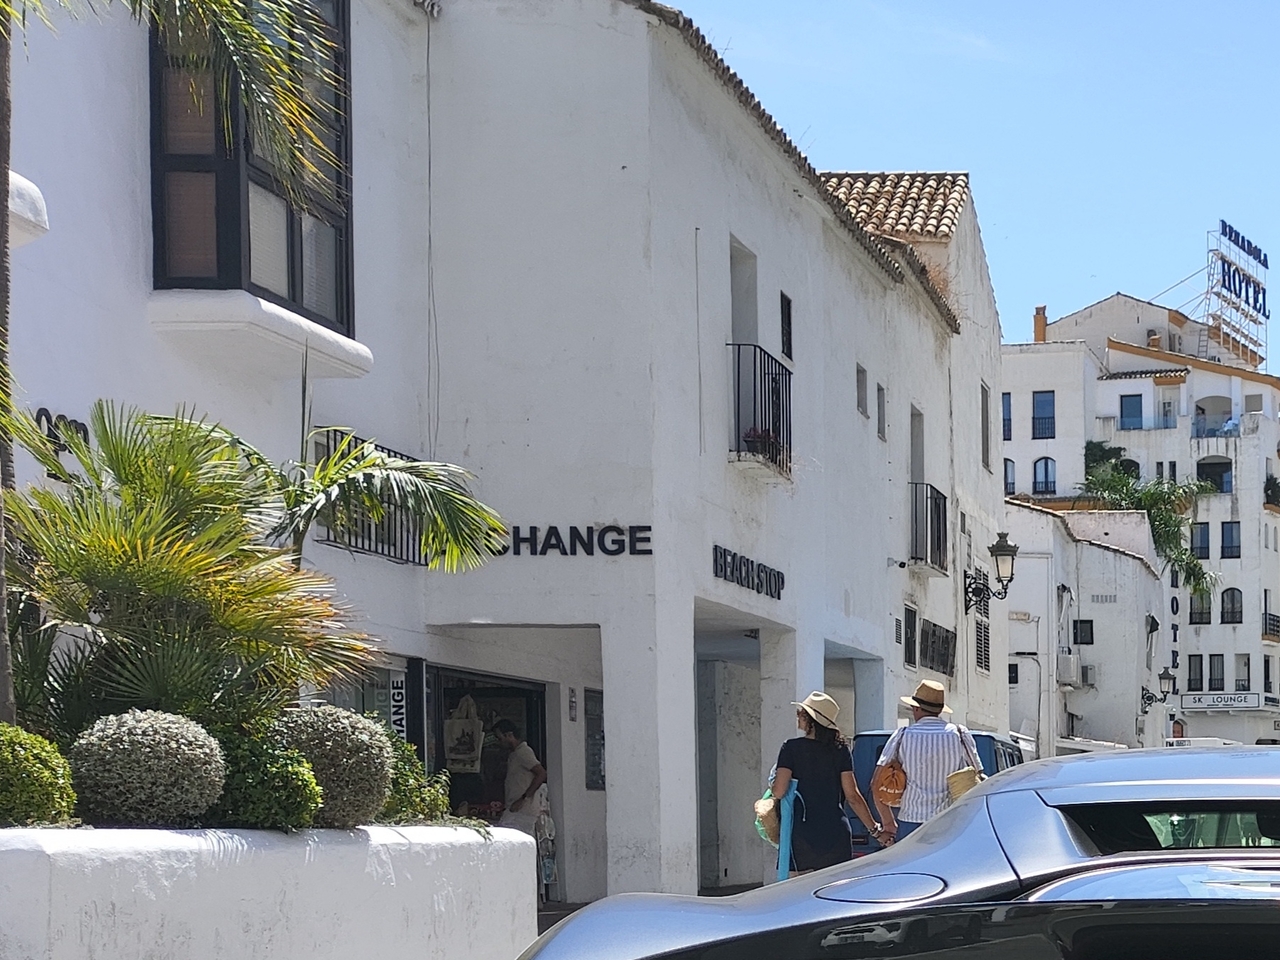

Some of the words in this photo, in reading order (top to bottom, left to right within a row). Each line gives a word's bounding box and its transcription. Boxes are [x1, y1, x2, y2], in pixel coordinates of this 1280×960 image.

[1221, 259, 1271, 320] HOTEL
[440, 525, 653, 556] HANGE
[713, 545, 755, 591] BEACH
[756, 563, 785, 600] STOP
[1192, 696, 1203, 704] SK
[1212, 695, 1248, 703] LOUNGE
